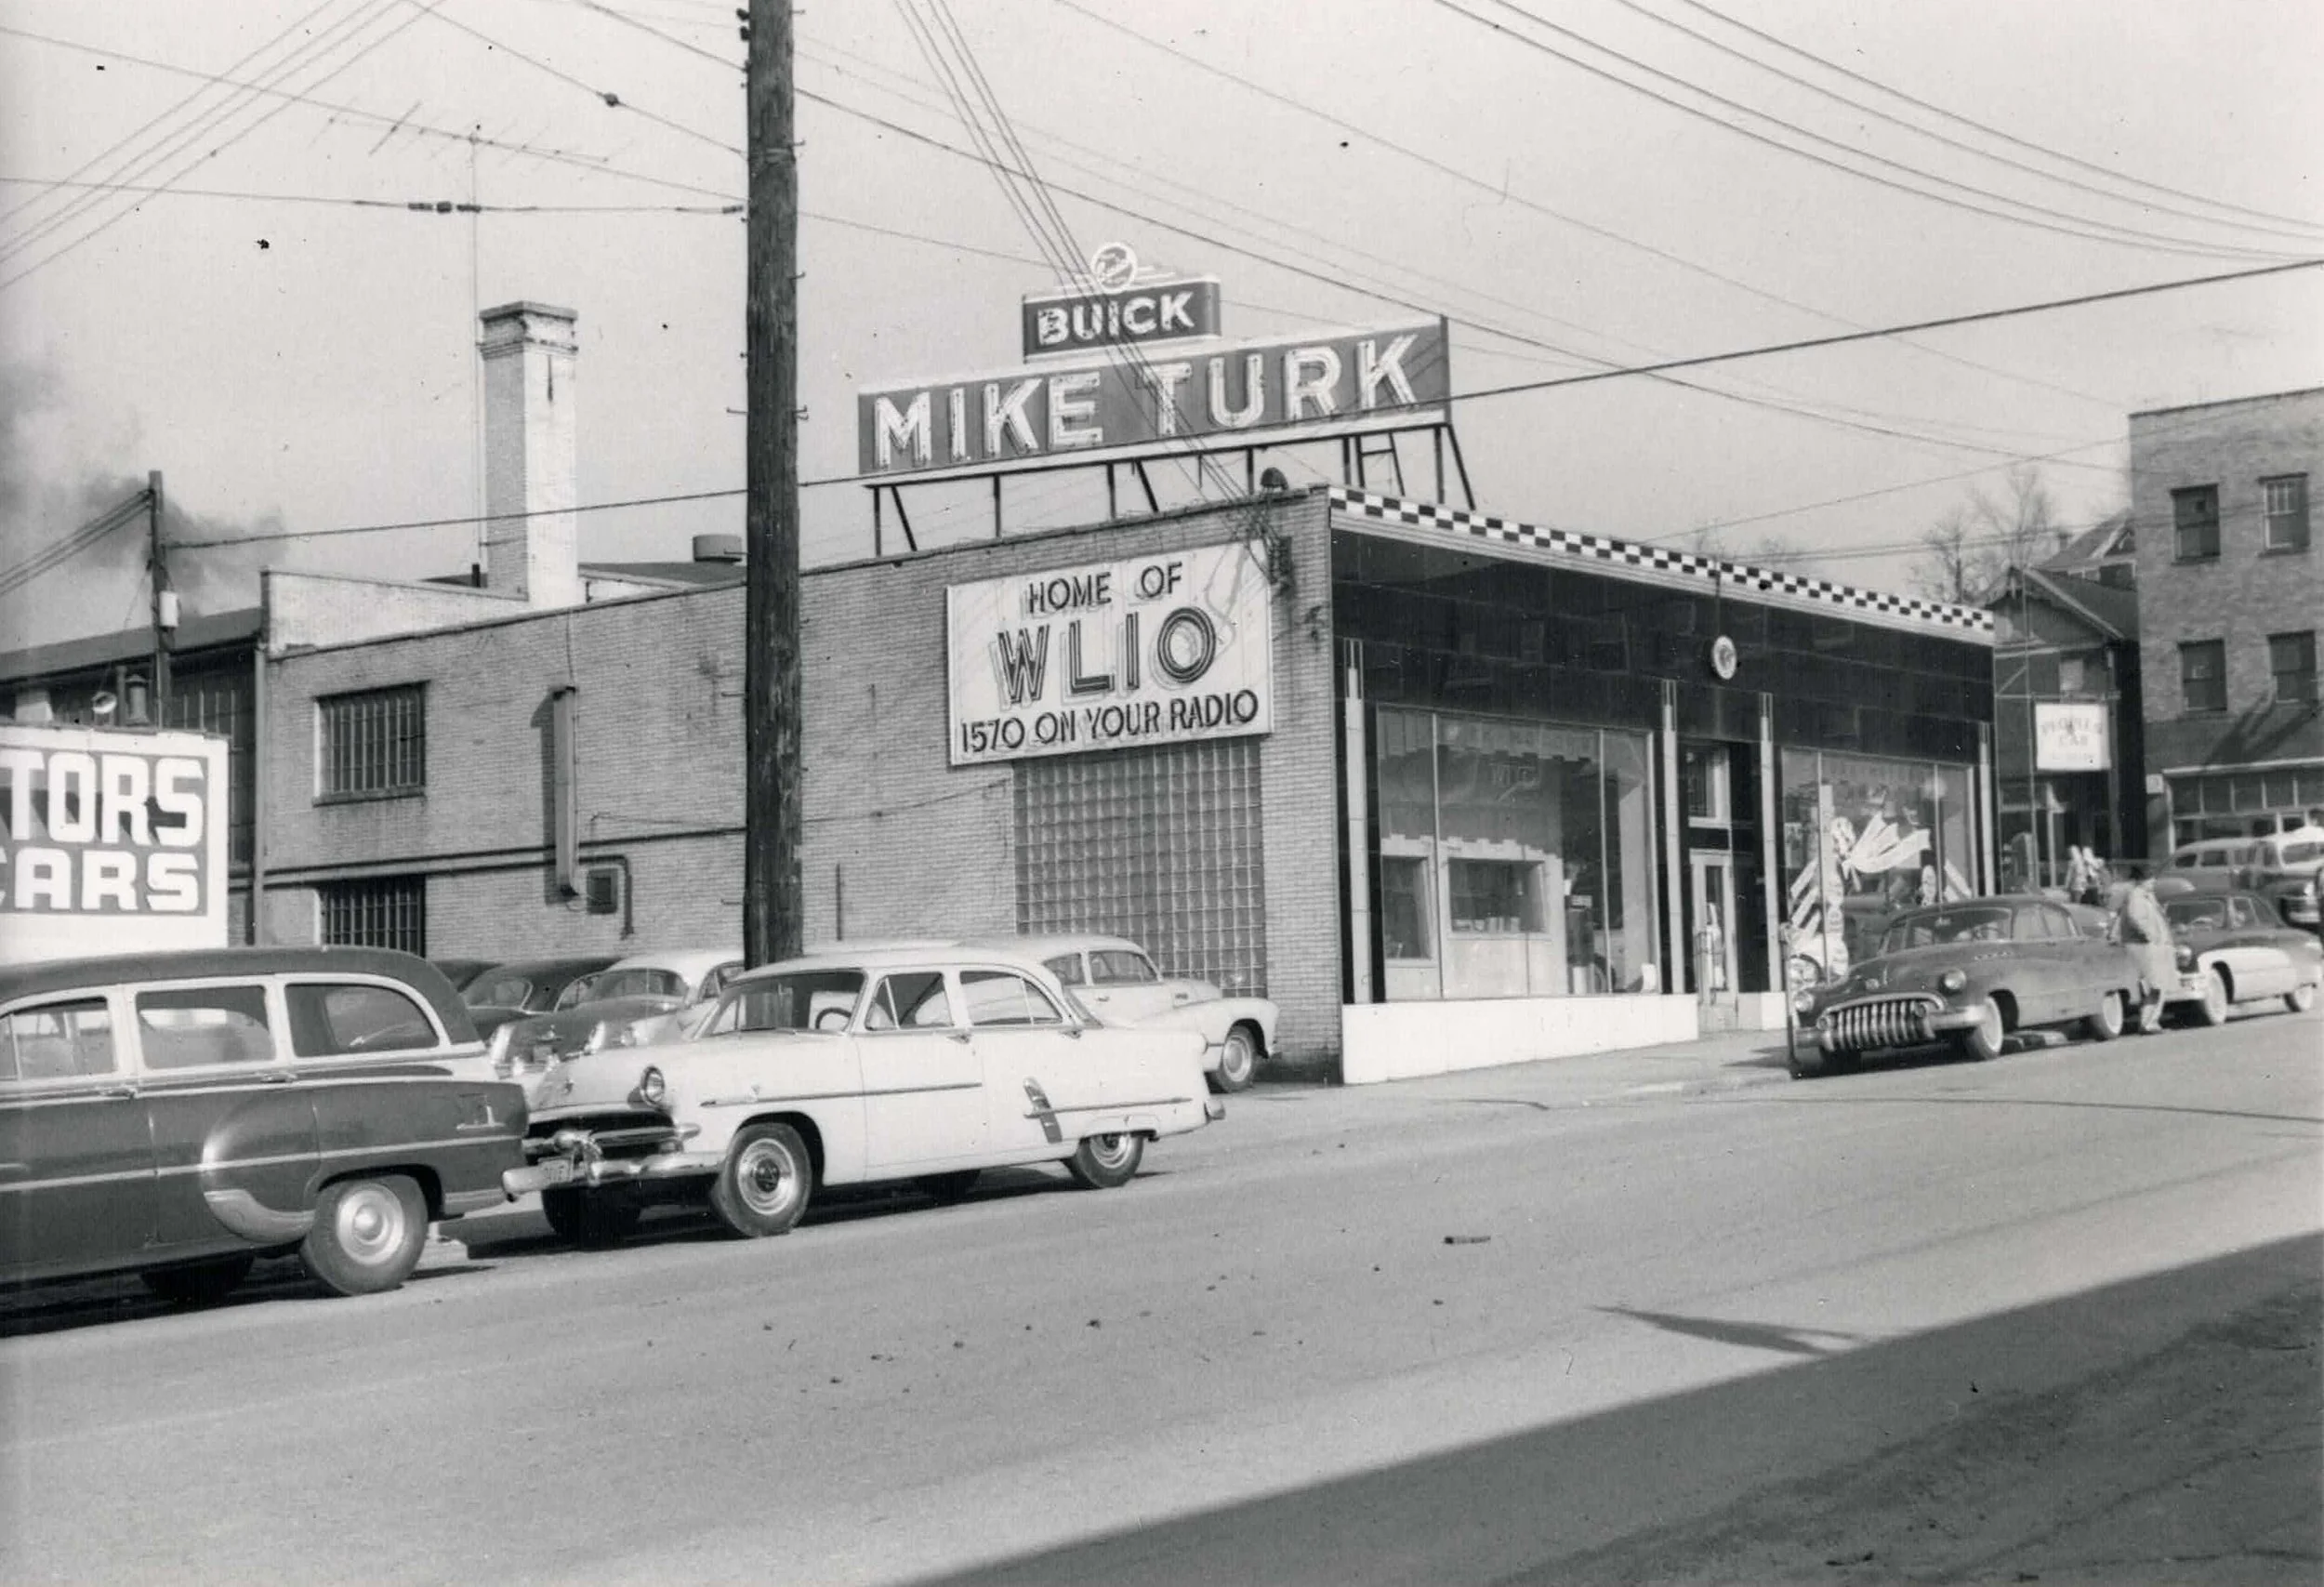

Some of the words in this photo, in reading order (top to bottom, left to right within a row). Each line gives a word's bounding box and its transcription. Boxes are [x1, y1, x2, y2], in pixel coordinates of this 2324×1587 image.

[1037, 291, 1195, 345] BUICK
[873, 372, 1103, 468] MIKE
[1140, 333, 1420, 436] TURK
[1028, 572, 1112, 614] HOME
[1141, 562, 1183, 599] OF
[997, 605, 1217, 705] WLIO
[960, 717, 1025, 753] 1570
[1035, 710, 1076, 745] ON
[1086, 701, 1161, 740] YOUR
[1170, 689, 1259, 732] RADIO
[0, 748, 205, 847] TORS
[0, 847, 199, 911] ARS
